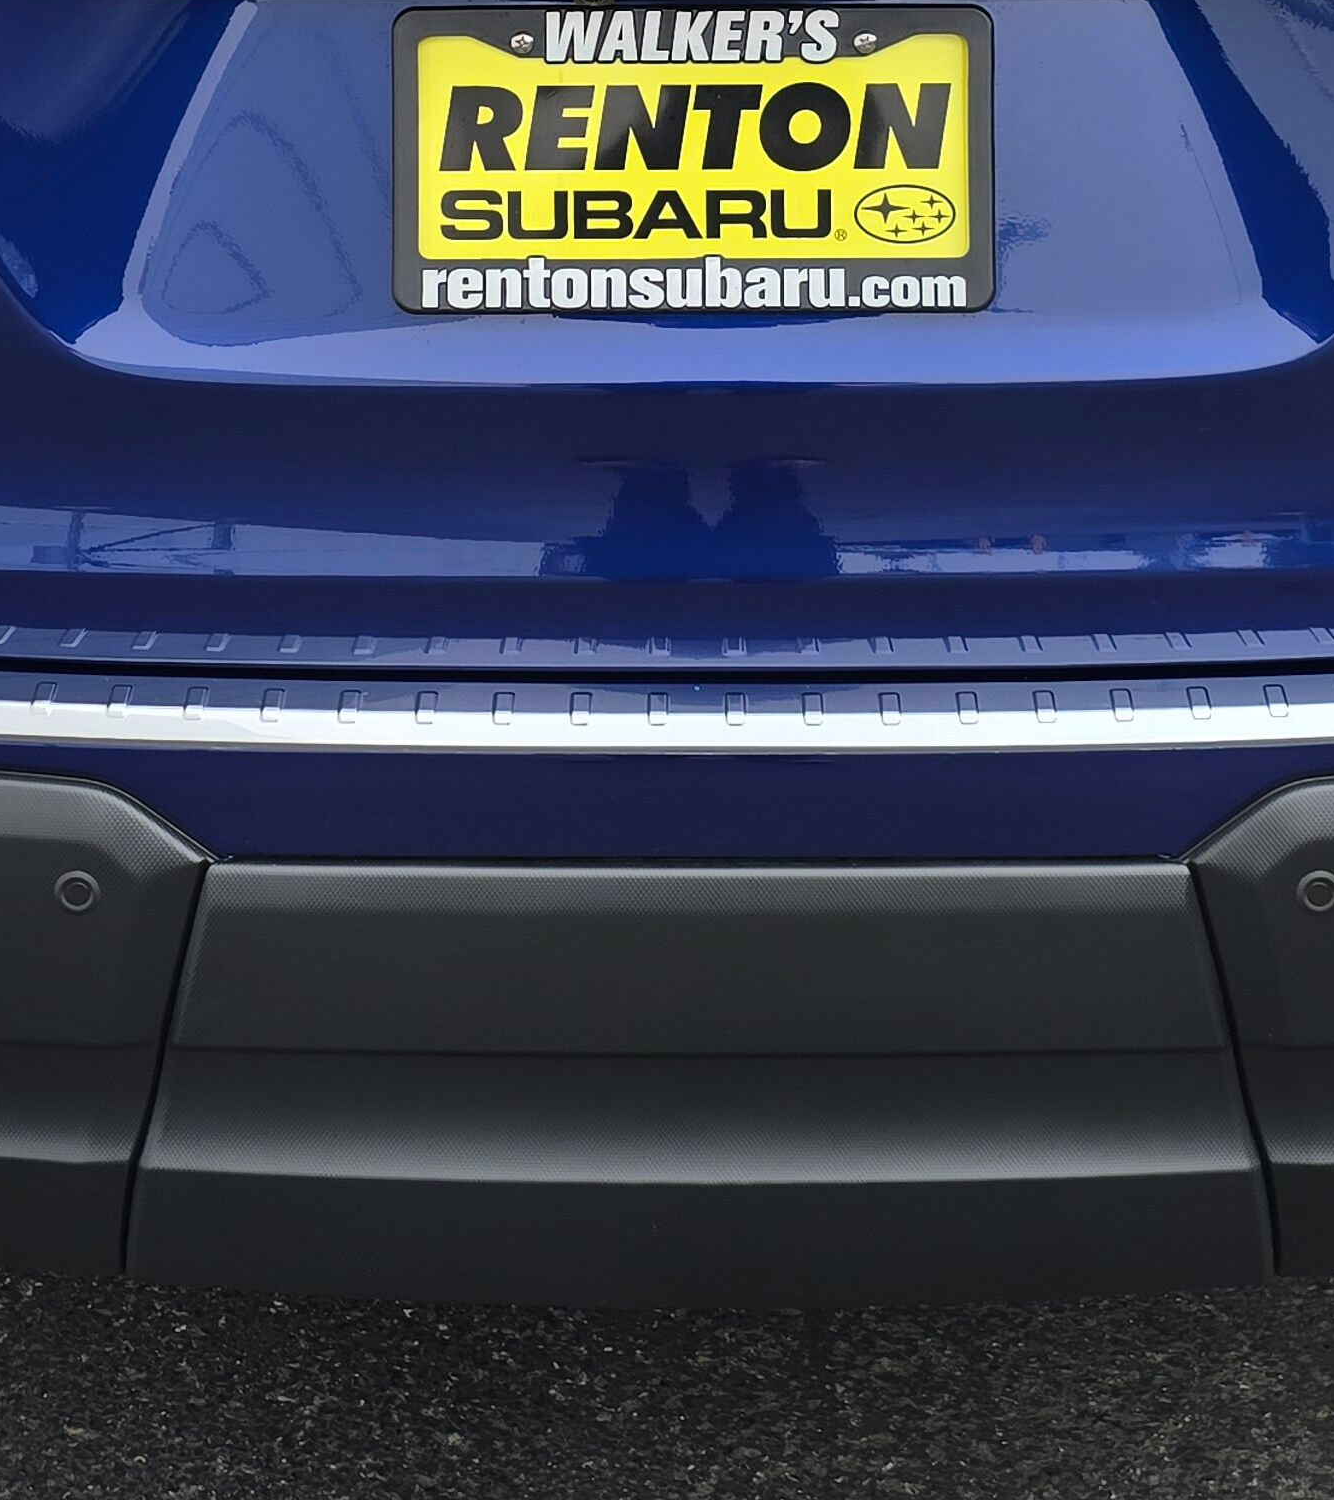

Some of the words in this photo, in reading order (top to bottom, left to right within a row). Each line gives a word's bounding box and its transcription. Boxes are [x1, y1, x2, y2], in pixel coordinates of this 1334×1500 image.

[546, 9, 840, 63] WALKER'S
[439, 82, 952, 171] RENTON
[440, 188, 833, 240] SUBARU
[422, 256, 968, 308] rentonsubaru.com
